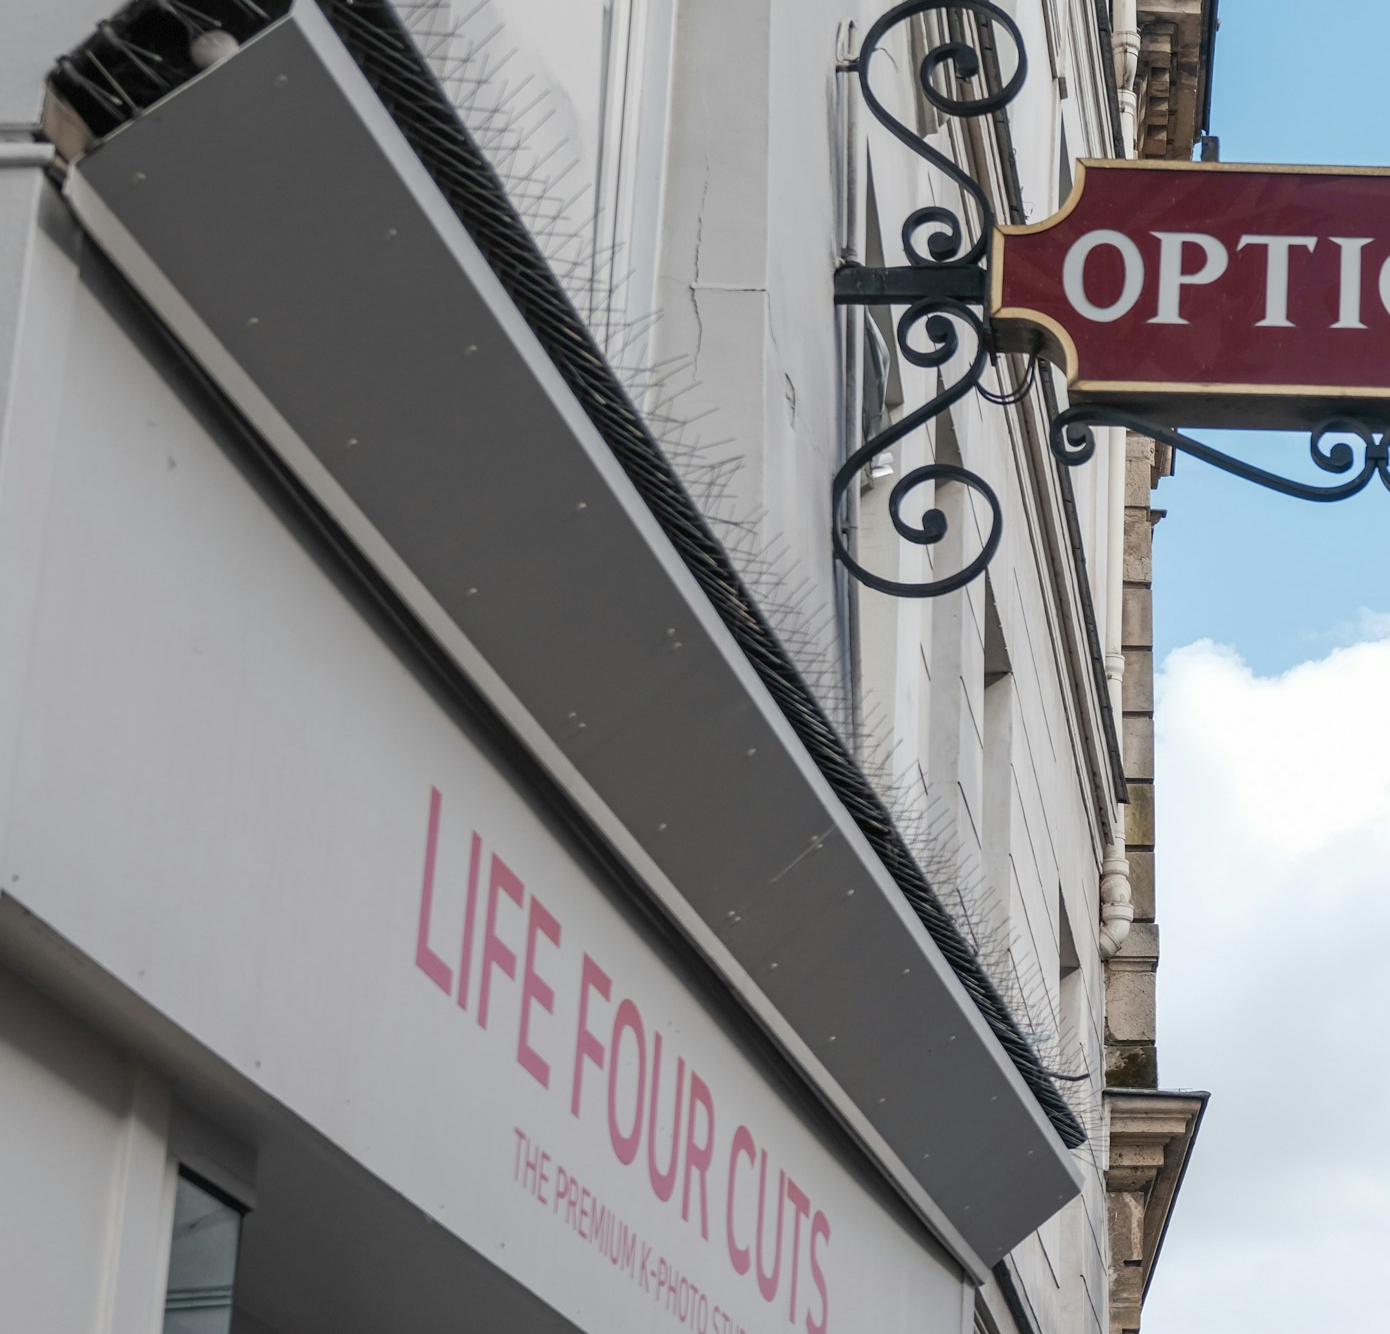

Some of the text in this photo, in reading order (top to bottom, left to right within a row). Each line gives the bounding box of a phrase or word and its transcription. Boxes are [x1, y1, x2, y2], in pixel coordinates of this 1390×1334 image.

[414, 785, 561, 1090] LIFE
[571, 951, 715, 1243] FOUR
[513, 1127, 550, 1205] THE
[554, 1174, 637, 1280] PREMIUM
